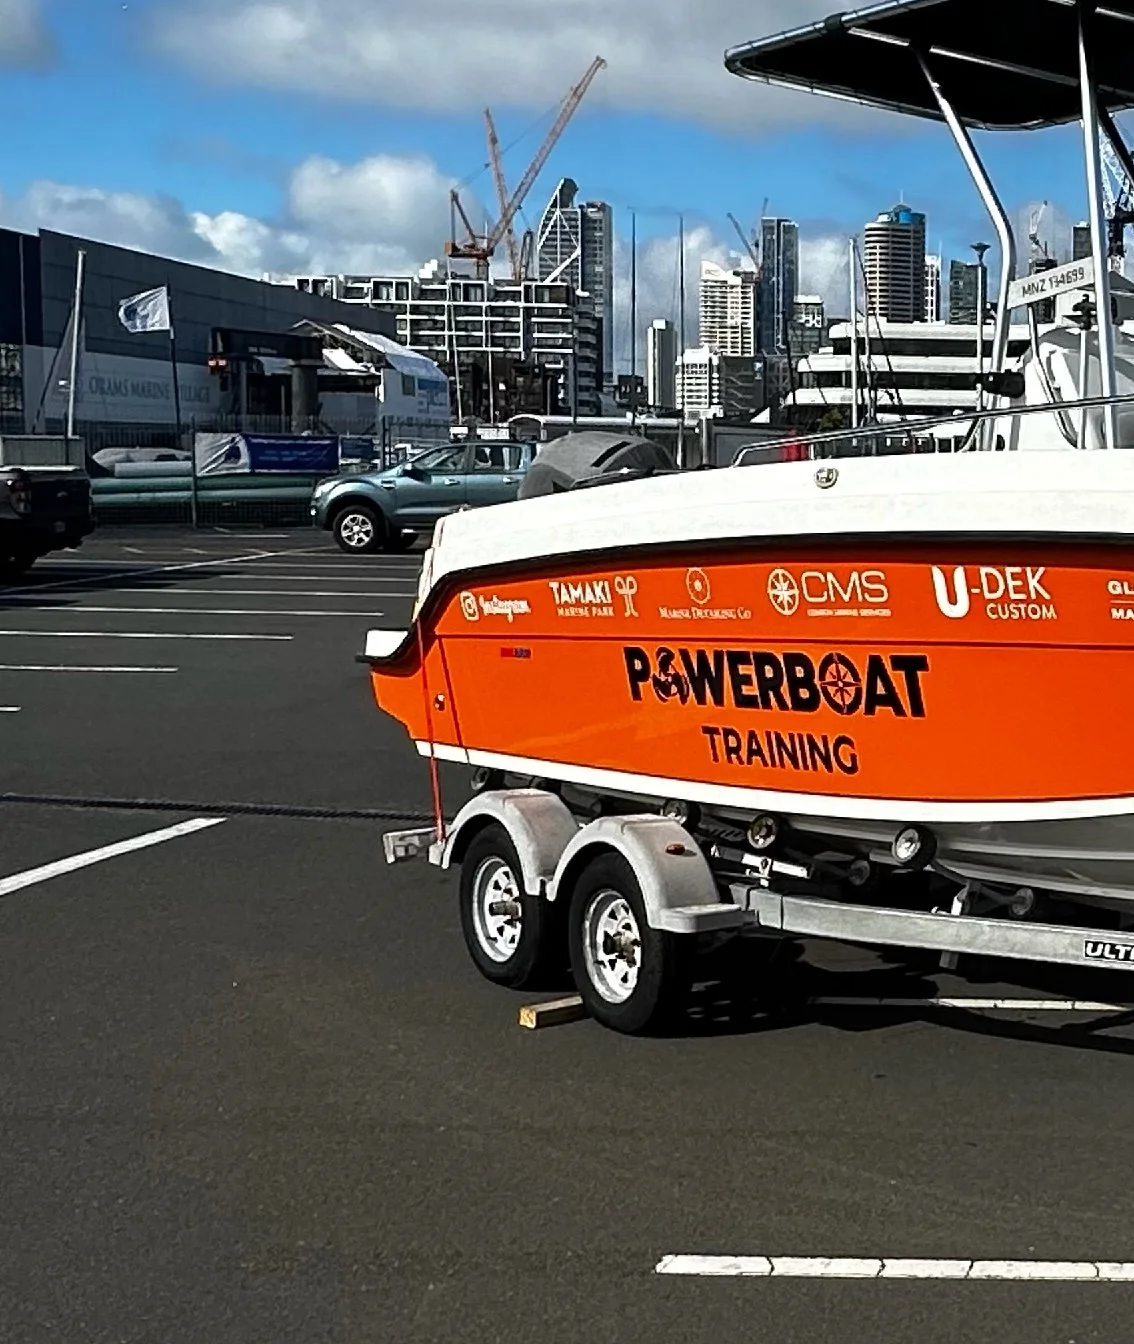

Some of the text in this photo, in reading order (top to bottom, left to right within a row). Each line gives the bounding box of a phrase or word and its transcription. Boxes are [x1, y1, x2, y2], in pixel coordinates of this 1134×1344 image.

[549, 580, 613, 605] TAMAKI
[801, 570, 889, 603] CMS
[986, 603, 1057, 620] CUSTOM
[623, 646, 929, 718] POWERBOAT
[701, 725, 858, 775] TRAINING
